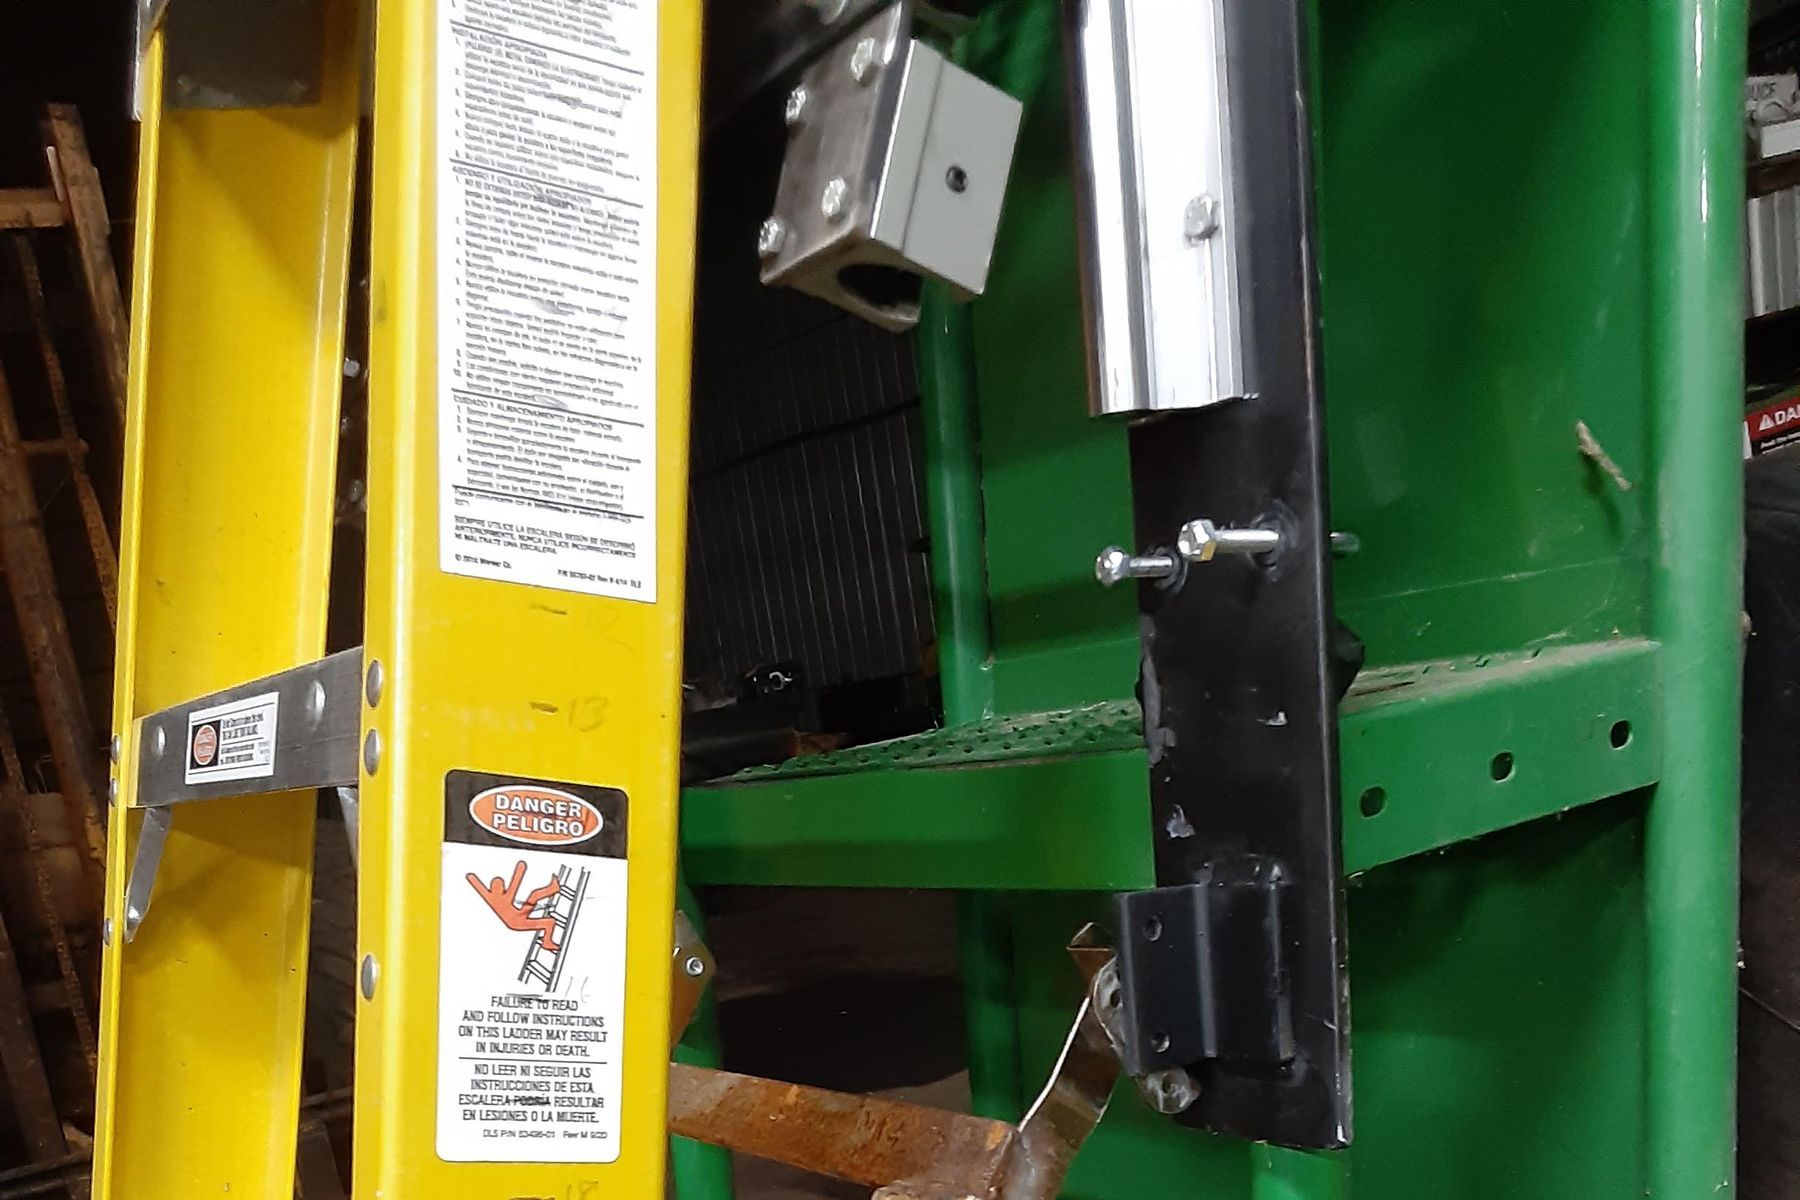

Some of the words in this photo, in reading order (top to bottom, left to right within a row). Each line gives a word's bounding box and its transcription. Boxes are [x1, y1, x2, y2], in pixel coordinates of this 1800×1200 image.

[496, 794, 582, 817] DANGER
[493, 813, 584, 836] PELIGRO
[491, 996, 533, 1009] FAILURE
[538, 999, 549, 1009] TO
[552, 1000, 578, 1010] READ
[463, 1010, 483, 1021] AND
[488, 1011, 529, 1024] FOLLOW
[533, 1014, 604, 1027] INSTRUCTIONS
[459, 1025, 473, 1036] ON
[476, 1026, 499, 1037] THIS
[503, 1027, 542, 1039] LADDER
[546, 1030, 567, 1040] MAY
[570, 1031, 608, 1042] RESULT
[476, 1042, 486, 1053] IN
[490, 1042, 534, 1054] INJURIES
[539, 1045, 552, 1055] OR
[556, 1045, 590, 1056] DEATH.
[475, 1064, 488, 1075] NO
[492, 1065, 516, 1076] LEER
[520, 1065, 530, 1076] NI
[534, 1066, 569, 1077] SEGUIR
[573, 1067, 591, 1078] LAS
[471, 1079, 550, 1092] INSTRUCCIONES
[555, 1082, 567, 1092] DE
[570, 1082, 594, 1093] ESTA
[459, 1094, 511, 1105] ESCALERA
[555, 1097, 604, 1107] RESULTAR
[463, 1110, 475, 1120] EN
[480, 1110, 527, 1121] LESIONES
[531, 1111, 537, 1121] O
[542, 1111, 553, 1122] LA
[557, 1112, 599, 1122] MUERTE.
